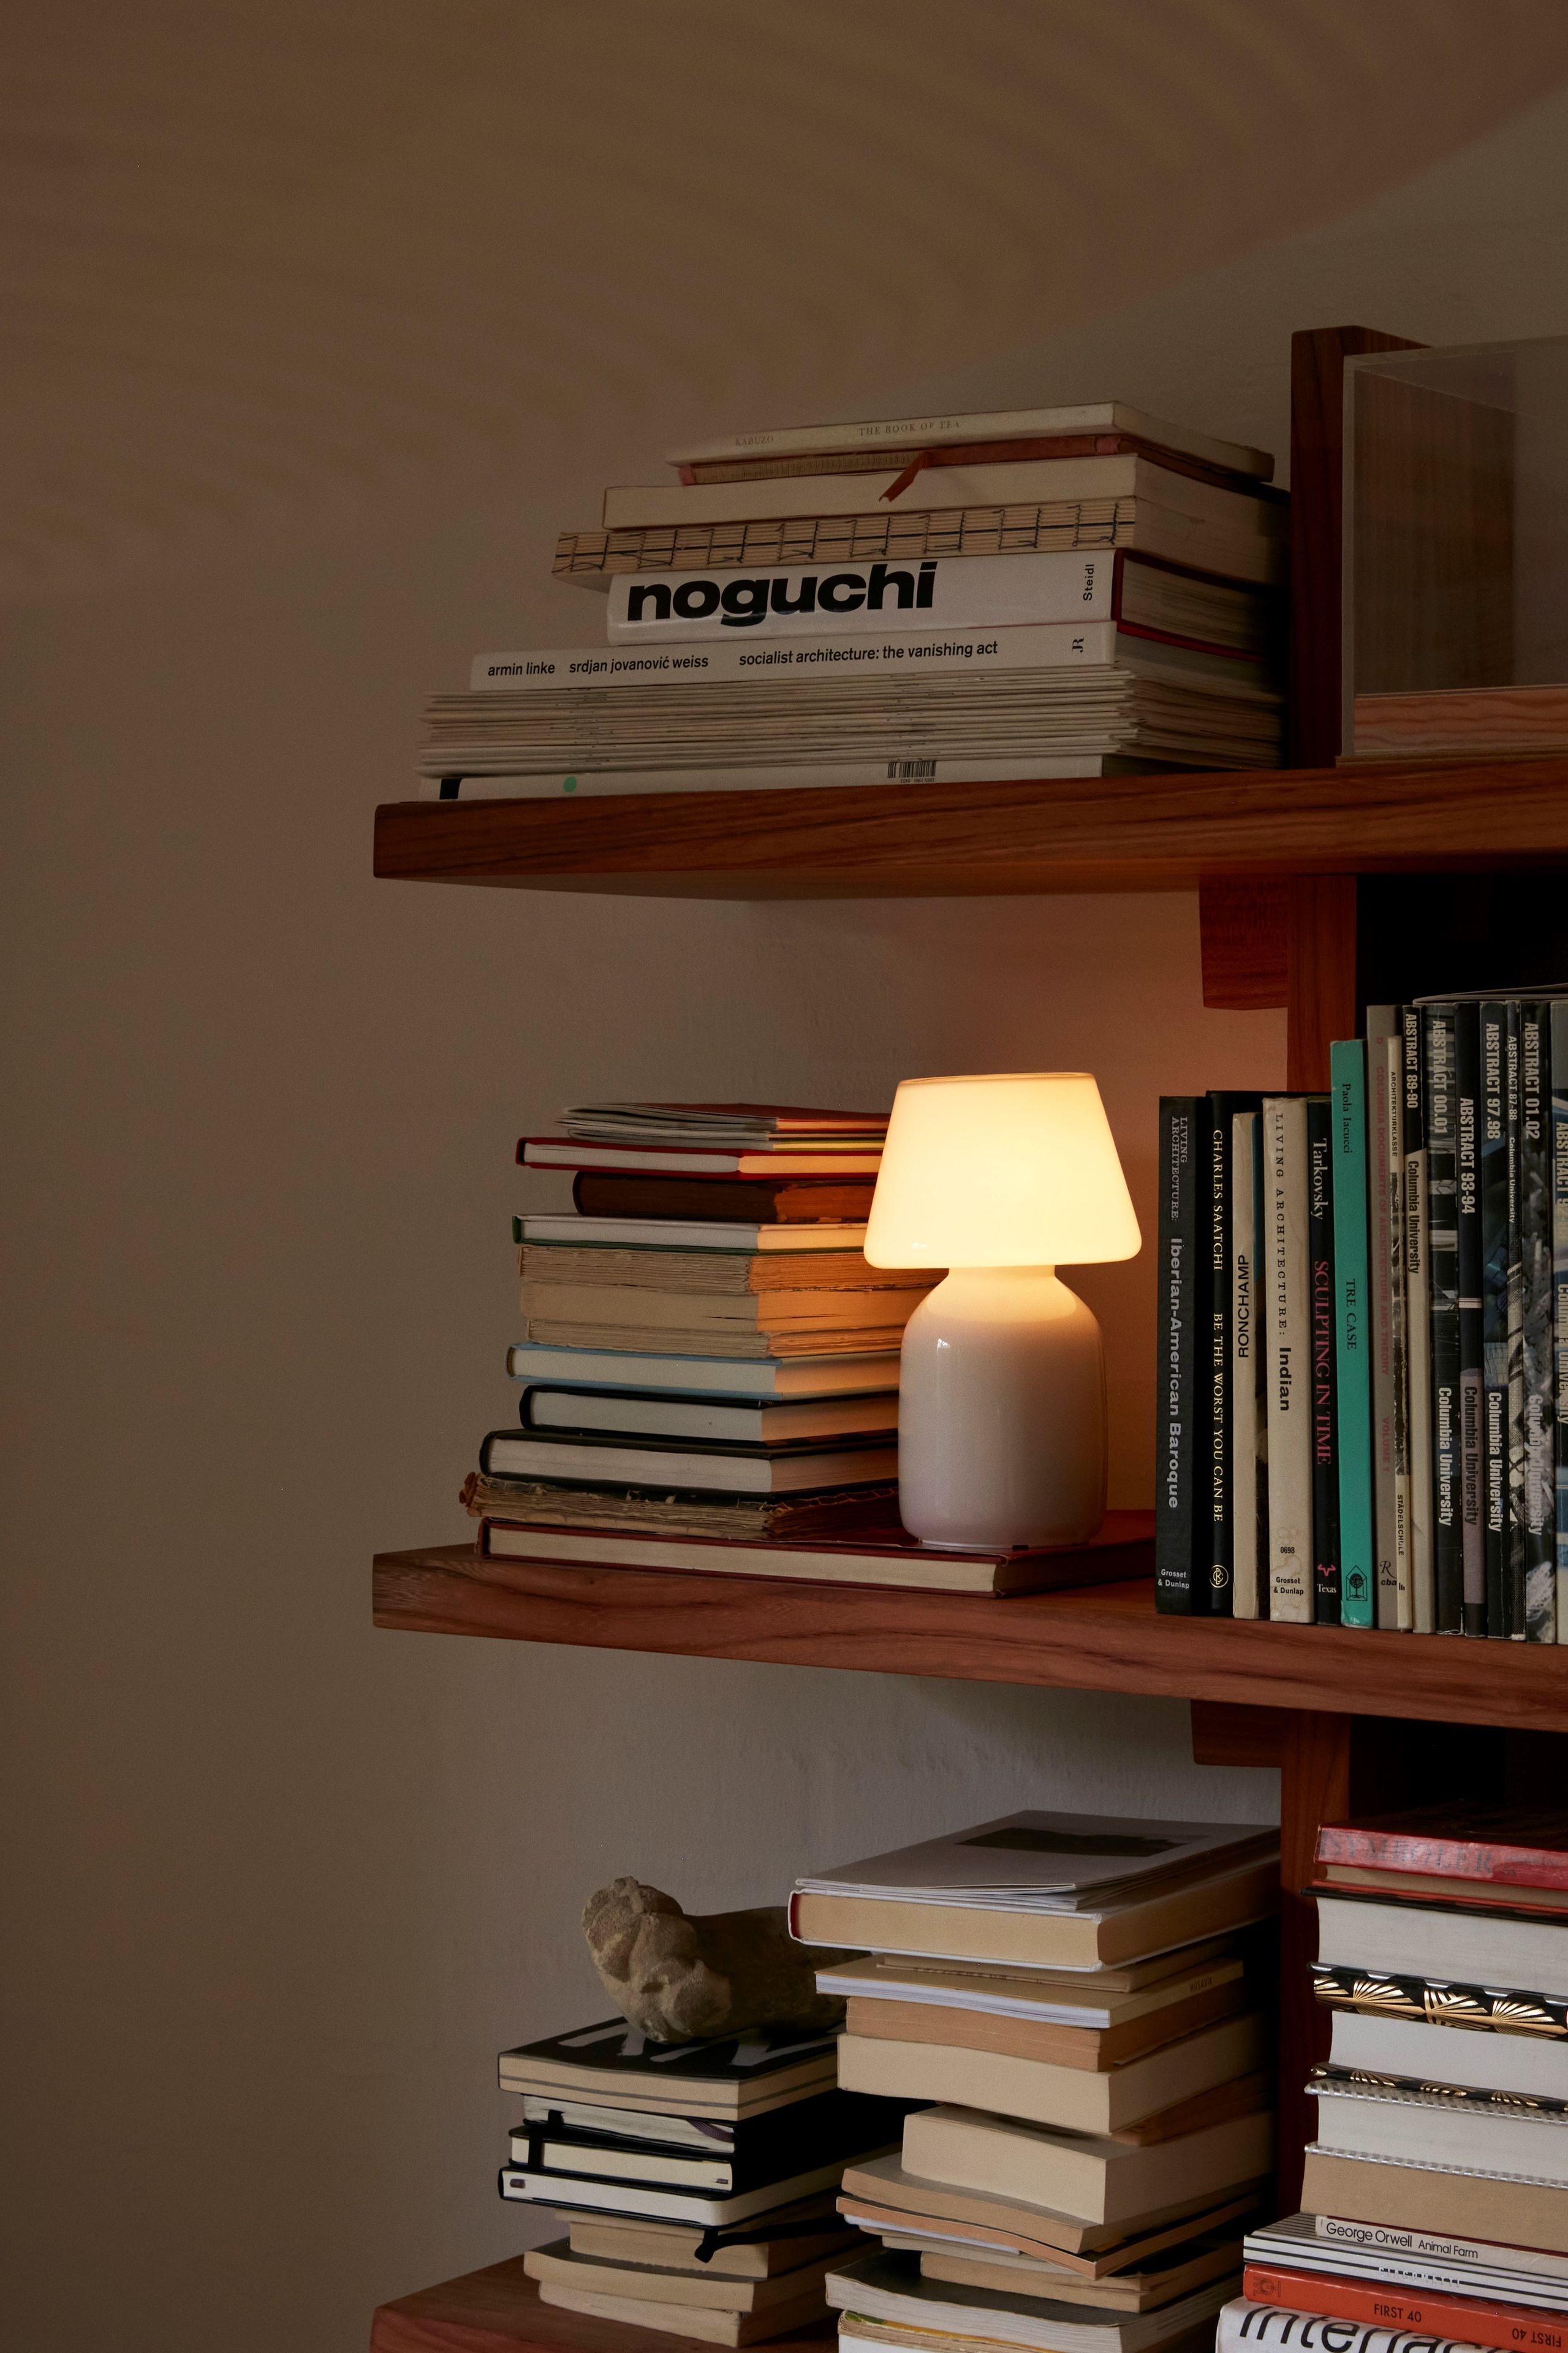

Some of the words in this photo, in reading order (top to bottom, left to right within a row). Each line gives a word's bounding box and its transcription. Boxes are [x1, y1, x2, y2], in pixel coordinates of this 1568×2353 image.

[859, 427, 881, 436] THE
[885, 423, 916, 434] BOOK
[940, 420, 960, 430] TEA
[627, 561, 938, 627] noguchi
[1083, 564, 1094, 601] Steidl
[488, 662, 523, 676] armin
[526, 661, 555, 675] linke
[569, 659, 608, 675] srdjan
[611, 656, 670, 673] jovanović
[673, 656, 709, 669] weiss
[739, 651, 793, 665] socialist
[796, 646, 879, 662] architecture:
[882, 645, 904, 659] the
[907, 642, 973, 657] vanishing
[977, 641, 998, 654] act
[1406, 1014, 1418, 1071] ABSTRACT
[1433, 1020, 1447, 1091] ABSTRACT
[1486, 1023, 1500, 1094] ABSTRACT
[1508, 1036, 1518, 1091] ABSTRACT
[1524, 1022, 1539, 1094] ABSTRACT
[1343, 1083, 1352, 1112] Paola
[1376, 1066, 1385, 1124] COLUMBIA
[1406, 1074, 1418, 1108] 89-90
[1509, 1093, 1518, 1121] 87-88
[1433, 1094, 1447, 1134] 00.01
[1460, 1097, 1475, 1169] ABSTRACT
[1487, 1098, 1501, 1140] 97.98
[1525, 1098, 1540, 1140] 01.02
[1343, 1118, 1352, 1154] Iacucci
[1509, 1137, 1518, 1178] Columbia
[1556, 1122, 1568, 1192] ABSTRACT
[1171, 1116, 1180, 1221] ARCHITECTURE:
[1213, 1129, 1223, 1199] CHARLES
[1311, 1137, 1328, 1220] Tarkovsky
[1379, 1199, 1387, 1214] OF
[1408, 1161, 1419, 1211] Columbia
[1461, 1172, 1475, 1214] 93-94
[1509, 1179, 1518, 1224] University
[1213, 1205, 1223, 1271] SAATCHI
[1379, 1217, 1388, 1302] ARCHITECTURE
[1408, 1215, 1420, 1274] University
[1276, 1189, 1287, 1335] ARCHITECTURE:
[1238, 1254, 1249, 1358] RONCHAMP
[1346, 1279, 1356, 1307] TRE
[1170, 1238, 1183, 1415] Iberian-American
[1213, 1313, 1223, 1330] BE
[1314, 1260, 1330, 1378] SCULPTING
[1347, 1313, 1357, 1351] CASE
[1381, 1305, 1389, 1328] AND
[1213, 1336, 1223, 1366] THE
[1381, 1332, 1390, 1376] THEORY
[1213, 1372, 1224, 1423] WORST
[1279, 1347, 1292, 1411] Indian
[1317, 1384, 1330, 1406] IN
[1317, 1411, 1332, 1465] TIME
[1438, 1387, 1452, 1450] Columbia
[1464, 1386, 1478, 1449] Columbia
[1488, 1392, 1502, 1455] Columbia
[1167, 1422, 1181, 1509] Baroque
[1213, 1429, 1224, 1461] YOU
[1213, 1466, 1224, 1499] CAN
[1439, 1454, 1453, 1526] University
[1464, 1453, 1479, 1525] University
[1488, 1460, 1504, 1533] University
[1213, 1504, 1224, 1521] BE
[1161, 1569, 1187, 1578] Grosset
[1165, 1579, 1190, 1590] Dunlap
[1281, 1587, 1304, 1596] Dunlap
[1317, 1584, 1337, 1593] Texas
[1326, 2222, 1373, 2243] George
[1375, 2230, 1412, 2247] Orwell
[1418, 2240, 1452, 2254] Animal
[1454, 2245, 1479, 2259] Farm
[1374, 2303, 1403, 2319] FIRST
[1407, 2310, 1422, 2323] 40
[1512, 2328, 1526, 2341] 40
[1531, 2334, 1562, 2349] FIRST
